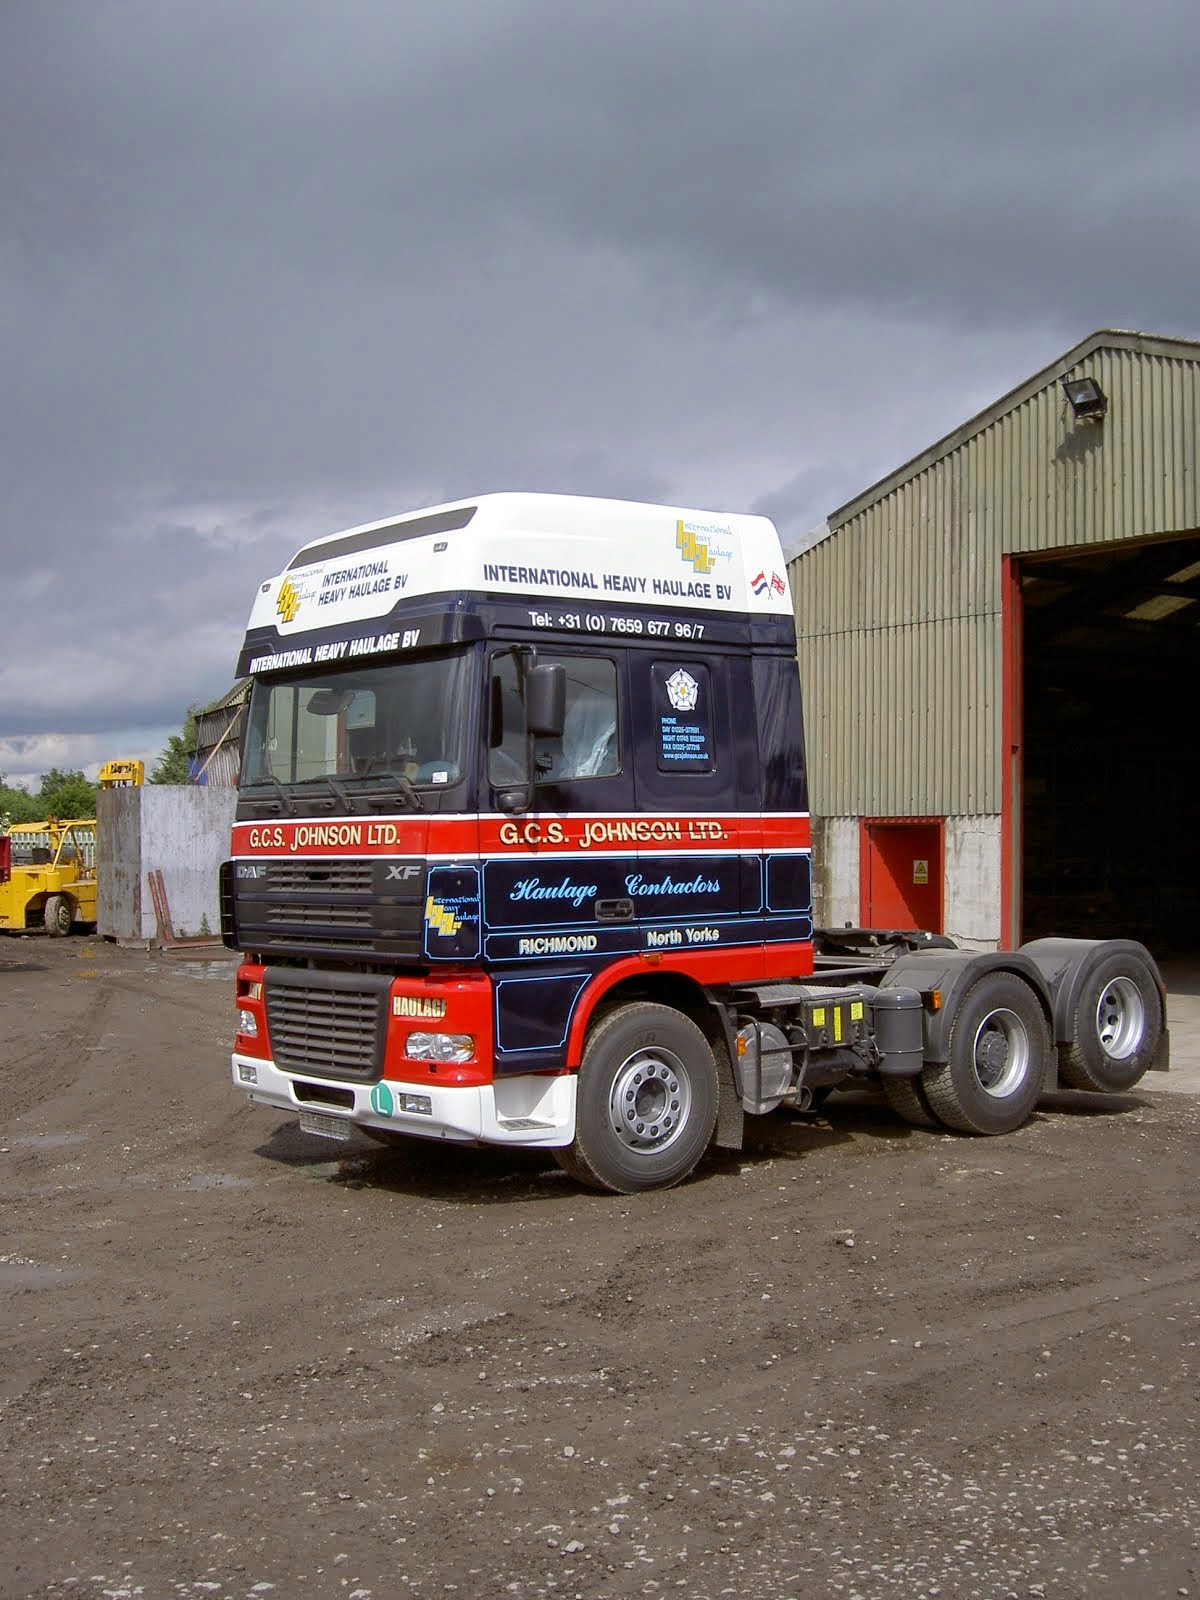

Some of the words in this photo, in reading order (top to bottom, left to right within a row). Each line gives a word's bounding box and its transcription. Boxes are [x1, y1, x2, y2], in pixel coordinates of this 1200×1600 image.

[322, 560, 389, 588] INTERNATIONAL
[483, 564, 598, 590] INTERNATIONAL
[603, 574, 647, 594] HEAVY
[653, 579, 711, 599] HAULAGE
[716, 585, 731, 600] BV
[318, 586, 347, 607] HEAVY
[348, 578, 392, 600] HAULAGE
[393, 574, 408, 590] BV
[528, 611, 553, 627] Tel:
[557, 614, 581, 629] +31
[586, 614, 605, 632] (0)
[610, 618, 643, 634] 7659
[647, 621, 671, 636] 677
[674, 622, 704, 639] 96/7
[249, 646, 312, 674] INTERNATIONAL
[314, 642, 347, 662] HEAVY
[350, 633, 399, 657] HAULAGE
[401, 629, 420, 648] BV
[250, 827, 285, 848] G.C.S.
[290, 824, 361, 852] JOHNSON
[368, 824, 401, 845] LTD.
[500, 823, 569, 845] G.C.S.
[579, 821, 681, 848] JOHNSON
[688, 821, 728, 840] LTD.
[237, 865, 266, 879] DAF
[385, 865, 421, 880] XF
[510, 877, 598, 907] Haulage
[625, 874, 721, 896] Contractors
[519, 935, 597, 955] RICHMOND
[647, 929, 683, 946] North
[686, 927, 720, 943] Yorks
[375, 1087, 389, 1114] L
